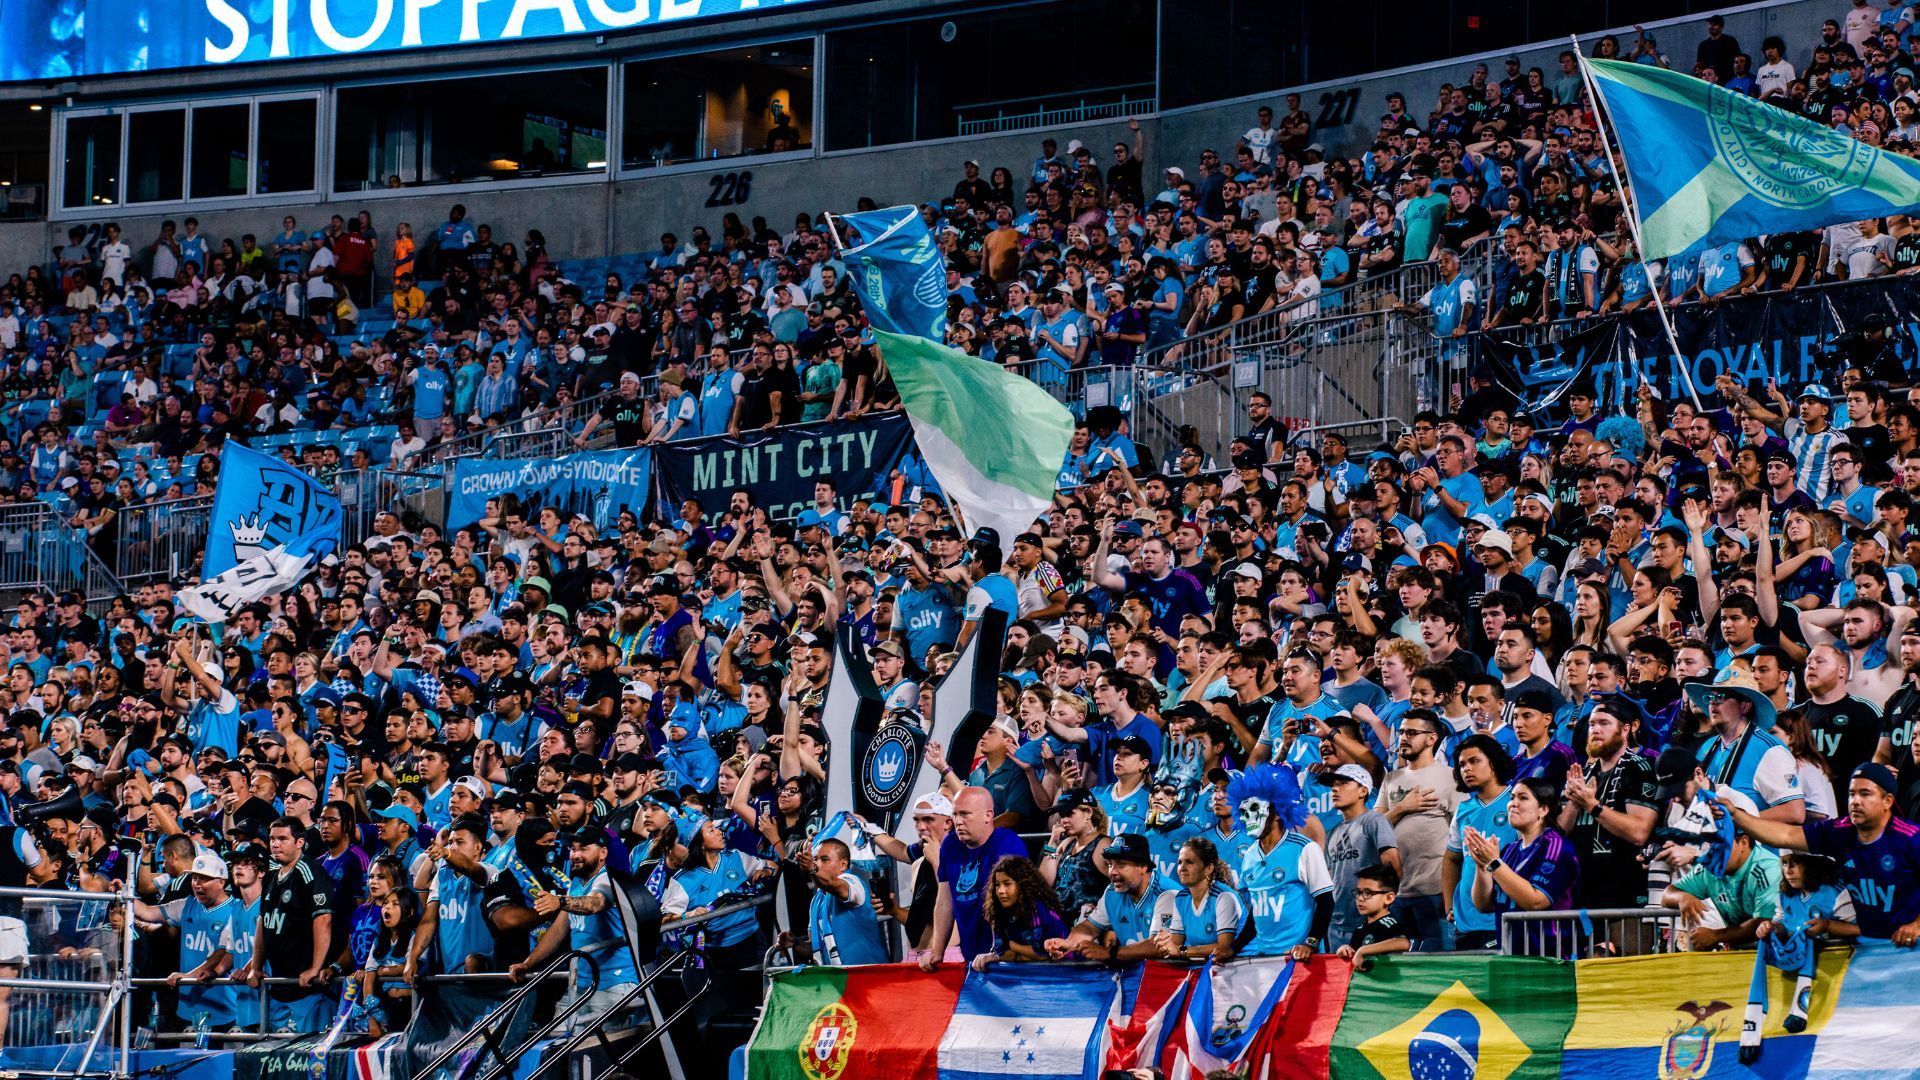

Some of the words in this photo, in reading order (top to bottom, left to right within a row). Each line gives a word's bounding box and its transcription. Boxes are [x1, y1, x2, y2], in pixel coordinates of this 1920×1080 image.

[204, 0, 701, 63] STOP
[1316, 87, 1361, 128] 227
[1468, 101, 1487, 113] ally
[1725, 140, 1748, 169] CITY
[1855, 144, 1872, 169] NTY
[706, 171, 752, 206] 226
[1753, 175, 1796, 199] NORTH
[1896, 246, 1920, 264] ally
[1671, 265, 1693, 282] ally
[1435, 300, 1453, 316] aly
[1510, 290, 1529, 306] ally
[1591, 355, 1658, 408] THE
[1668, 338, 1791, 398] ROYAL
[425, 381, 443, 390] ally
[616, 410, 639, 422] ally
[693, 444, 784, 491] MINT
[797, 429, 878, 478] CITY
[462, 469, 515, 494] CROWN
[563, 460, 641, 486] SYNDICATE
[1561, 488, 1580, 507] ally
[1148, 596, 1171, 619] ly
[911, 610, 942, 629] ally
[871, 728, 913, 751] CHARLOTTE
[1811, 728, 1842, 757] lly
[1891, 719, 1915, 747] all
[502, 741, 522, 758] lly
[1273, 734, 1308, 762] aly
[397, 772, 420, 784] Jee
[866, 783, 890, 803] FOOTBALL
[891, 782, 907, 799] CLUB
[1307, 790, 1343, 815] all
[1106, 816, 1128, 836] ly
[1150, 854, 1176, 878] lly
[1329, 848, 1359, 864] adidas
[1847, 879, 1896, 912] ally
[264, 908, 286, 935] ally
[439, 897, 468, 923] ally
[185, 931, 215, 957] ally
[234, 931, 254, 954] al
[260, 1055, 283, 1076] TEA
